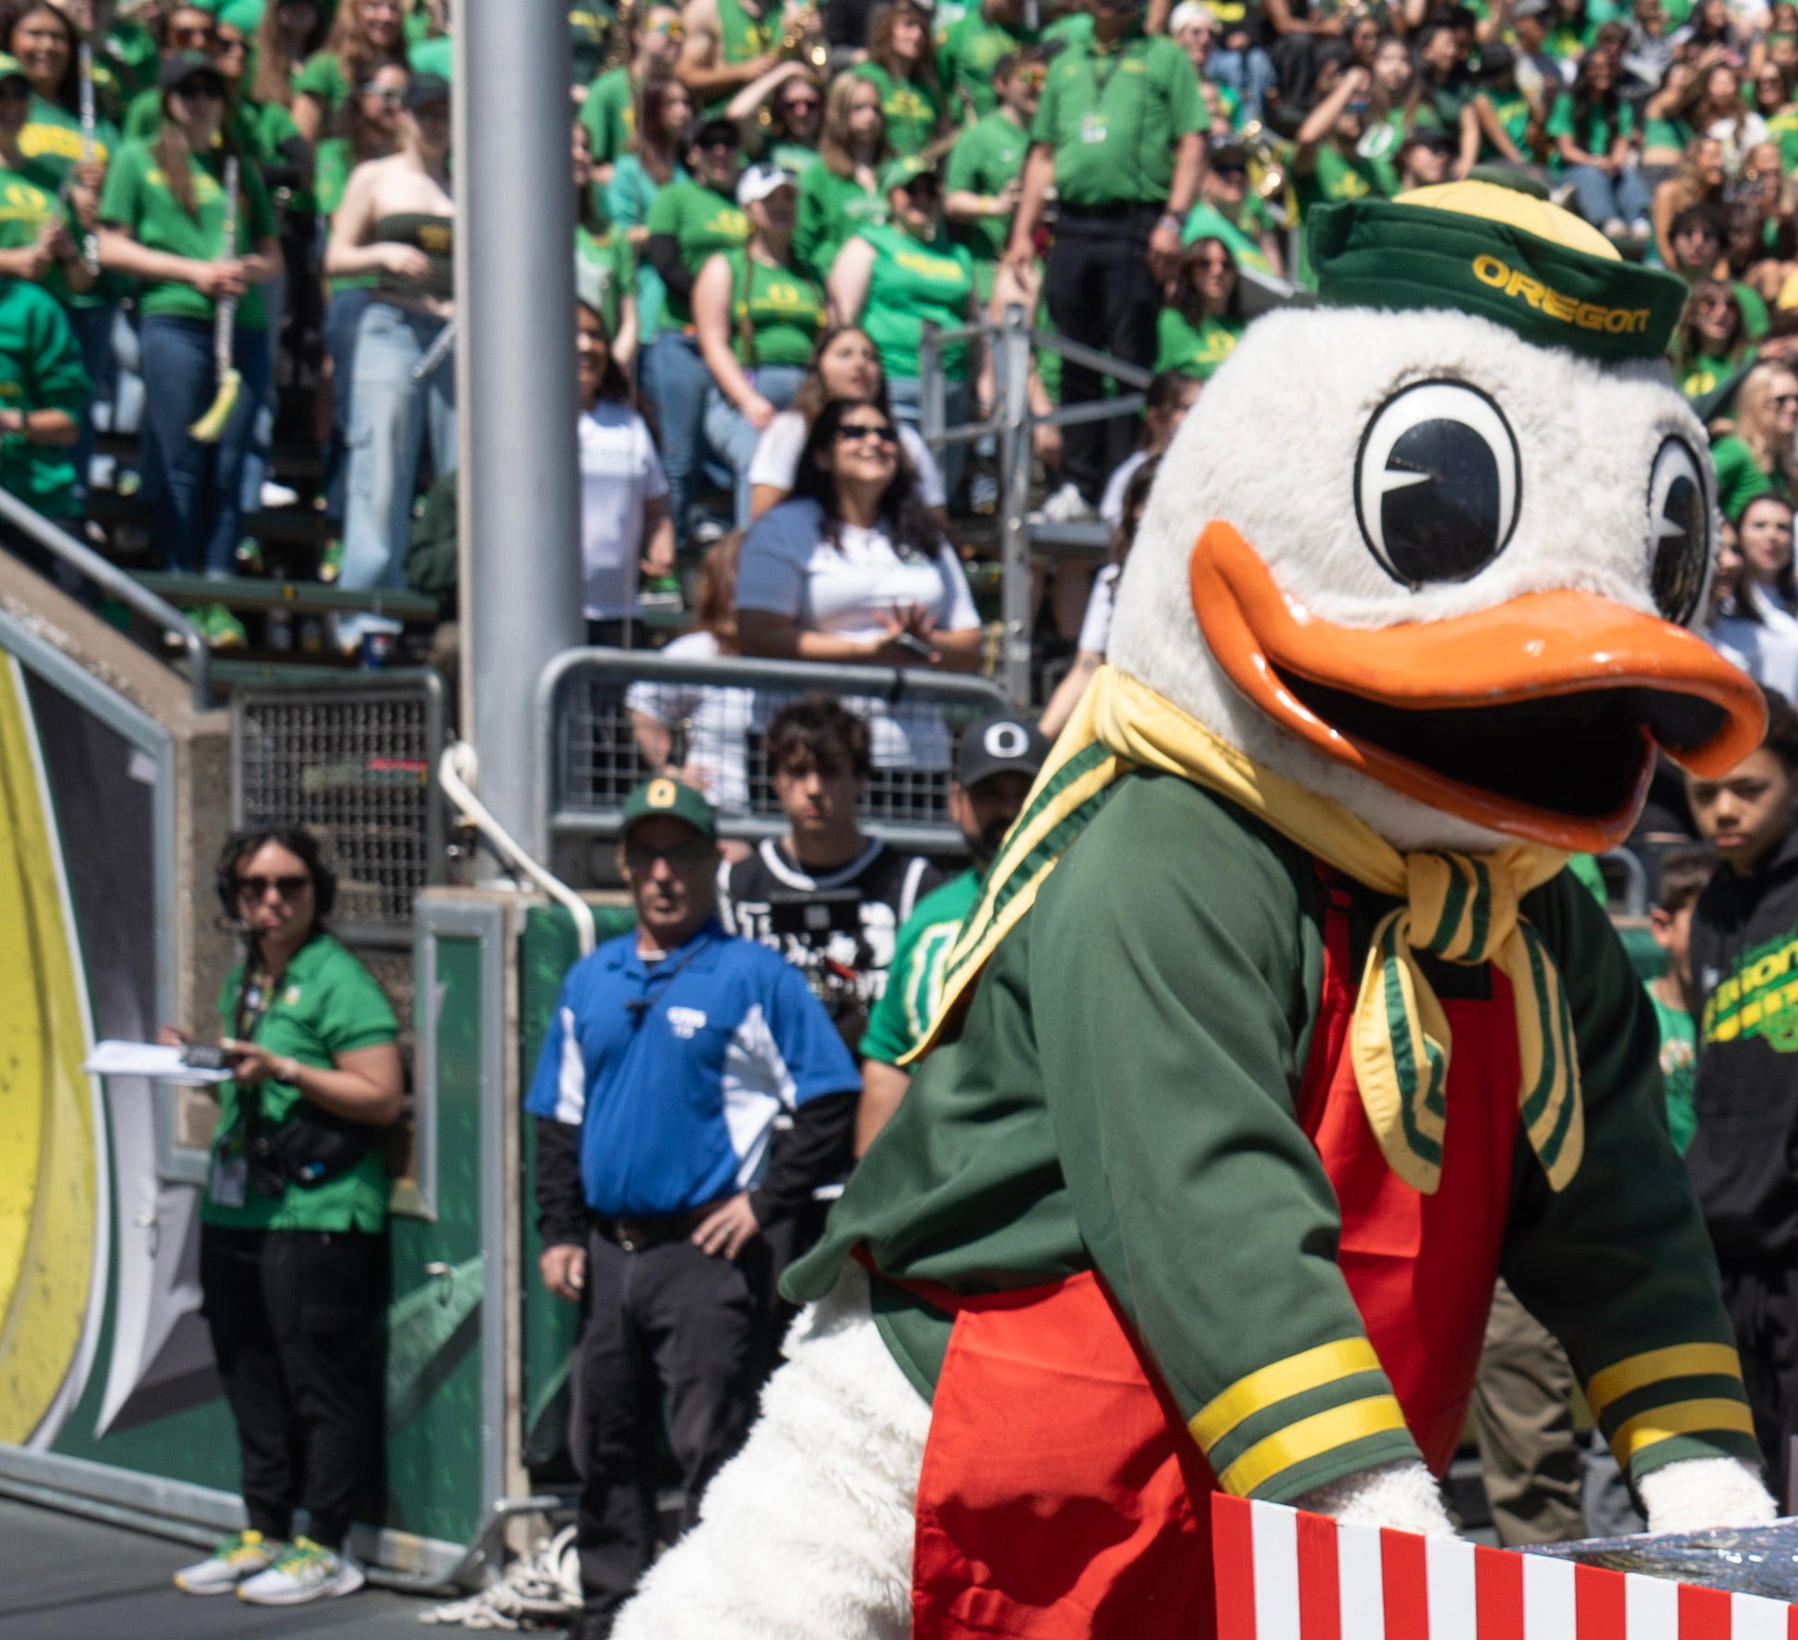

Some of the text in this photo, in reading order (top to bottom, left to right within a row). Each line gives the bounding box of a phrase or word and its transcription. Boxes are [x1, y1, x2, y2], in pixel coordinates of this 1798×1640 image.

[1472, 253, 1650, 333] OREGON
[983, 721, 1030, 759] O
[646, 778, 677, 809] O
